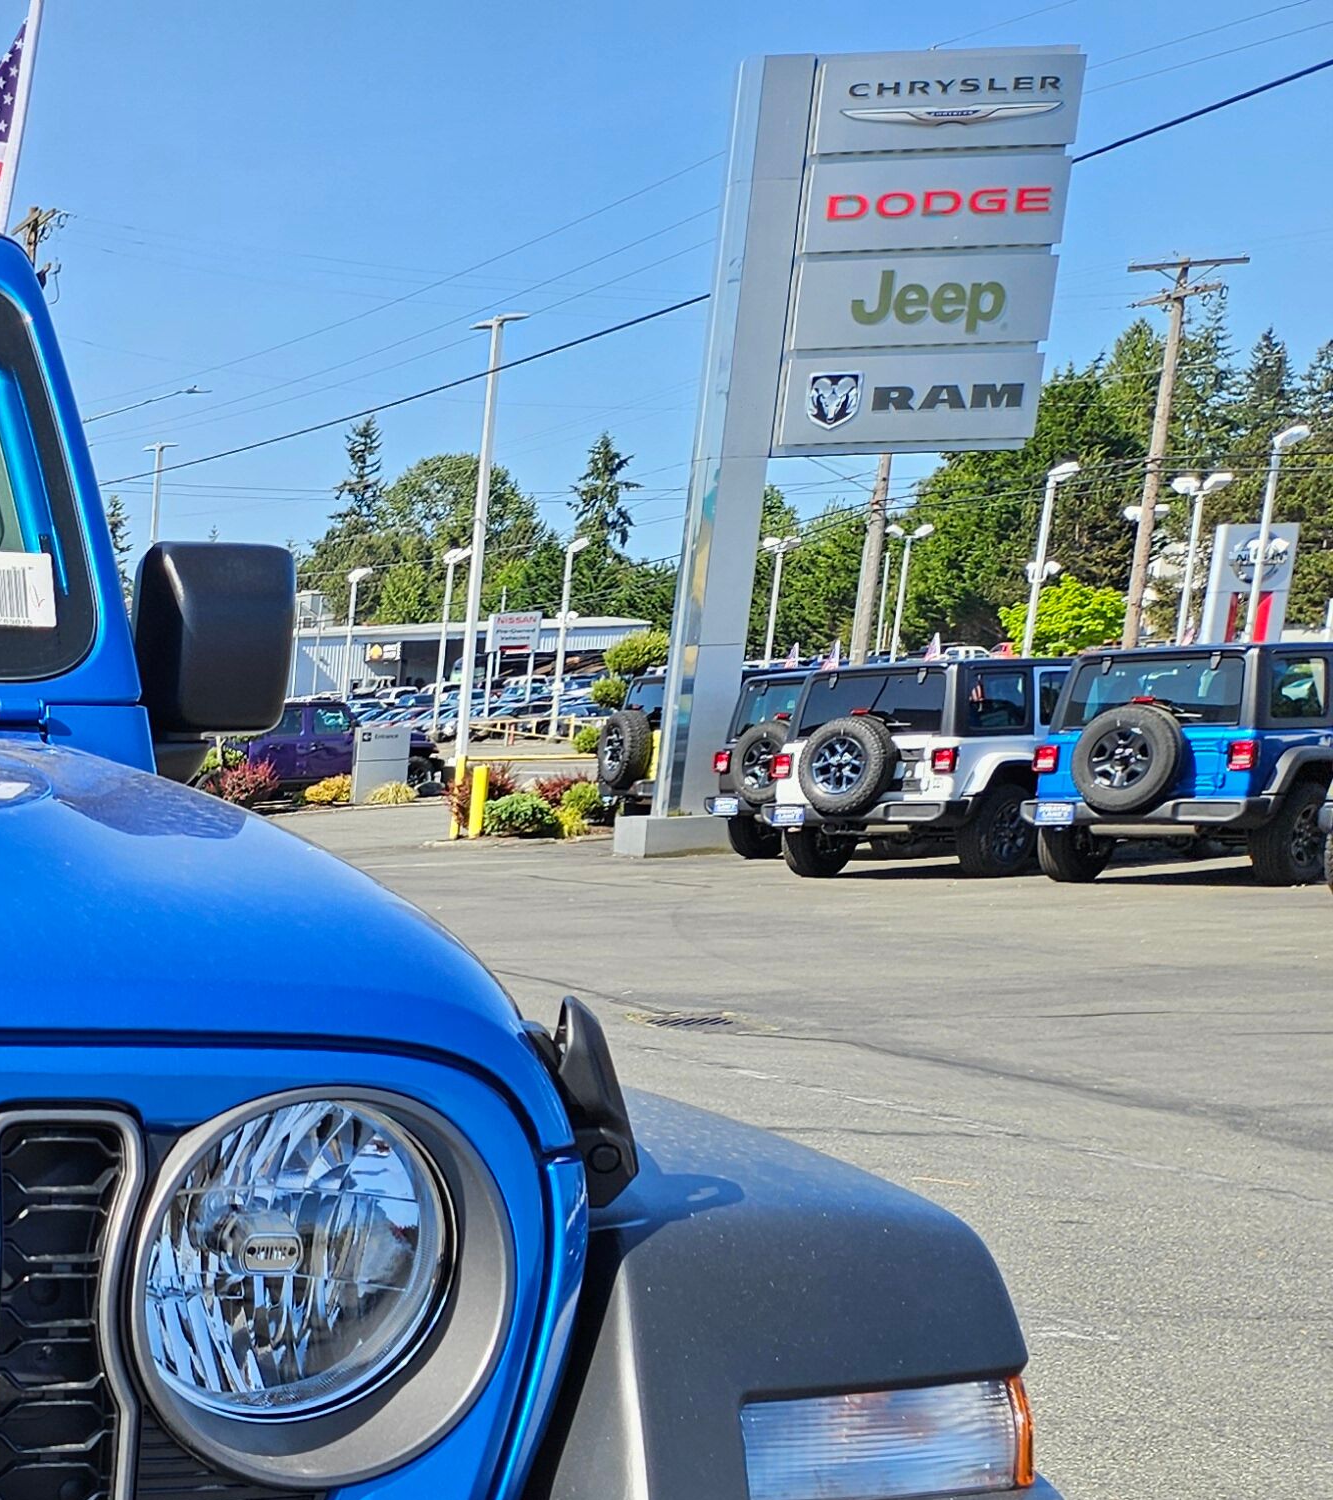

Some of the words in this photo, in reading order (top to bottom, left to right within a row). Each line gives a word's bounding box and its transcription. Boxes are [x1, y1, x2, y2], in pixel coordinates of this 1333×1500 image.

[848, 75, 1062, 97] CHRYSLER
[826, 186, 1053, 222] DODGE
[850, 269, 1007, 334] Jeep
[870, 382, 1025, 411] RAM
[497, 616, 537, 625] NISSAN
